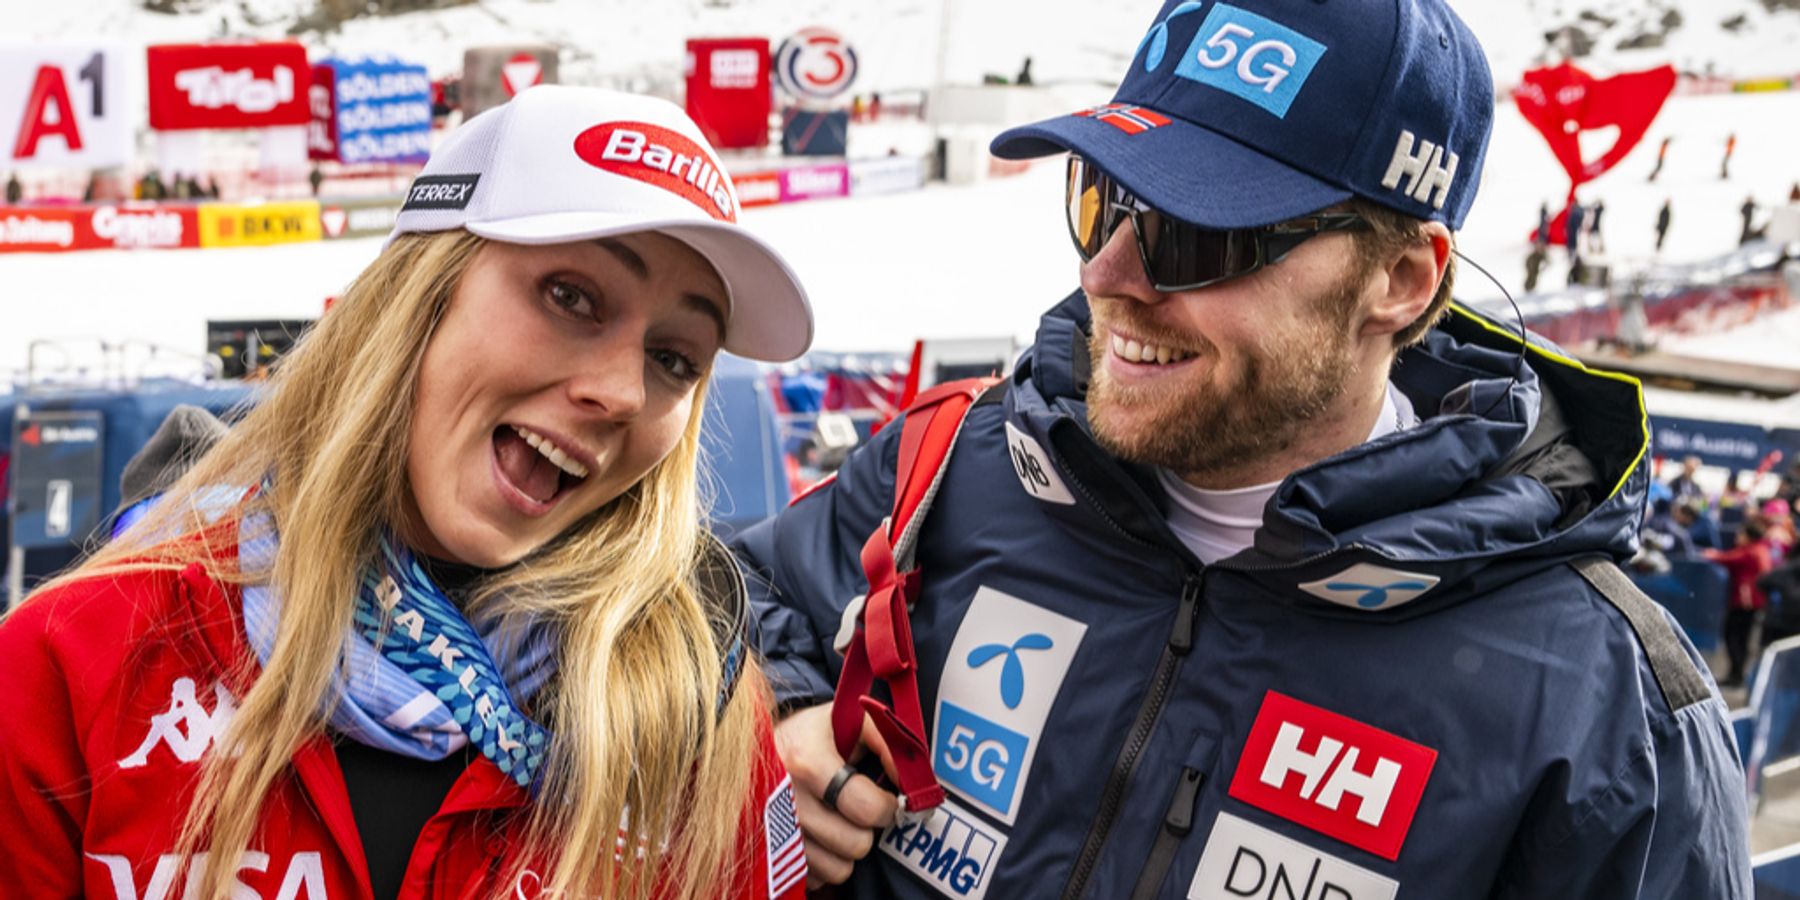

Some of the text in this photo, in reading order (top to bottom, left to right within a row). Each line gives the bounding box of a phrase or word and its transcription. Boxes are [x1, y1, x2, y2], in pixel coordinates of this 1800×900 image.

[174, 64, 295, 113] Tirol
[1197, 22, 1297, 94] 5G
[409, 182, 472, 203] TERREX
[602, 127, 732, 221] Barilla
[1381, 129, 1458, 209] HH
[1011, 439, 1051, 495] DNB
[1691, 432, 1758, 460] Austria
[375, 575, 522, 760] OAKLEY
[942, 723, 1010, 792] 5G
[1259, 720, 1403, 827] HH
[886, 820, 981, 897] KPMG
